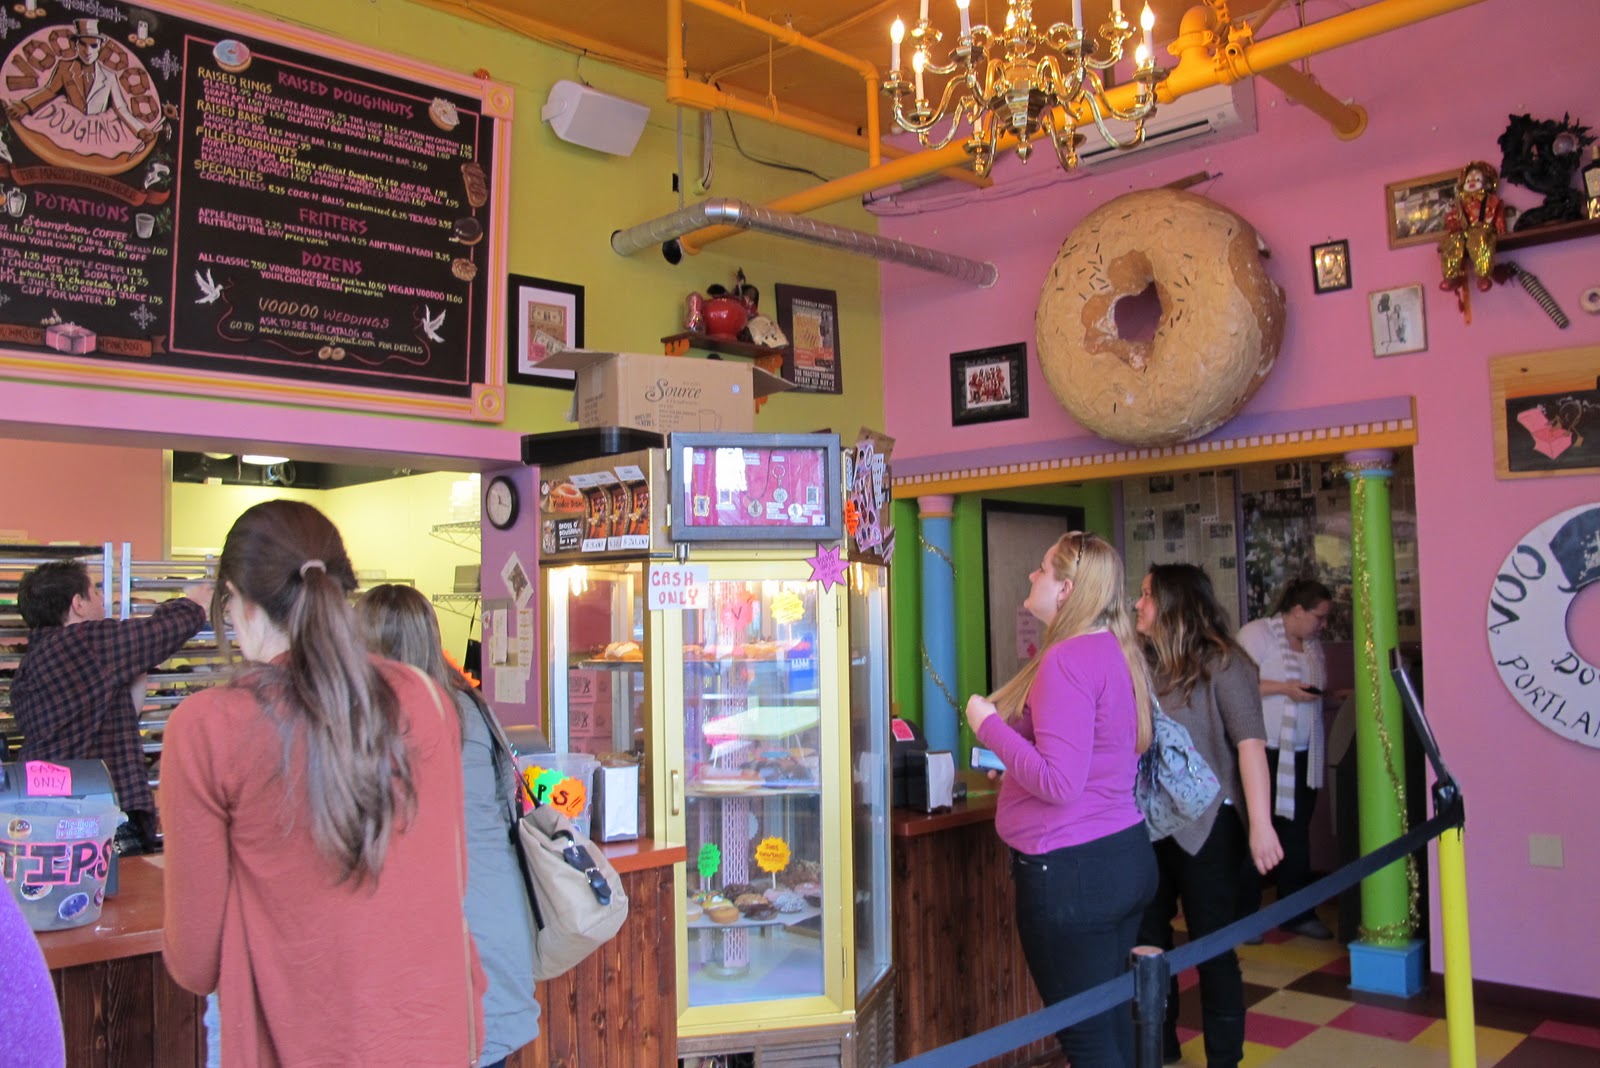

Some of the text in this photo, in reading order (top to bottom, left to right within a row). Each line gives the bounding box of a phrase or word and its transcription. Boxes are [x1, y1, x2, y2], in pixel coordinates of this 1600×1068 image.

[198, 66, 272, 94] RAISED RINGS
[278, 71, 414, 119] RAISED DOUGHNUTS
[197, 99, 264, 125] RAISED BARS
[203, 80, 459, 148] GLAZED CHOCOLATE FROSTING THE CAPTAIN CAPTAIN
[204, 88, 458, 155] GRAPE APE DIRT DOUGHNUT MIAMI VICE BERRY NO NAME
[205, 95, 435, 157] DOUBLE BUBBLE OLD DIRTY BASTARD ORANGUTANG
[196, 126, 298, 157] FILLED DOUGHNUTS
[203, 121, 298, 149] MAPLE BLAZER BLUNT
[203, 112, 428, 171] CHOCOLATE BAR 1.25 MAPLE BAR BACON MAPLE BAR 2.50
[194, 159, 264, 182] SPECIALTIES
[201, 153, 411, 204] RASPBERRY ROMEO LEMON POWDERED SUGAR
[202, 137, 431, 193] PORTLAND CREAM Portland's official Doughnut GAY BAR
[263, 158, 443, 205] CREAM MANGO TANGO VOODOO DOLL
[34, 190, 130, 223] POTATIONS
[346, 202, 390, 217] customized
[23, 214, 128, 242] Stumptown COFFEE
[199, 216, 284, 238] FRITTER OF THE DAY
[199, 207, 434, 259] APPLE FRITTER MEMPHIS MAFIA THAT PEACH
[299, 207, 368, 235] FRITTERS
[28, 236, 147, 262] YOUR OWN CUP FOR OFF
[36, 230, 124, 249] REFILLS 1.75
[2, 248, 143, 276] TEA 1.25 HOT APPLE CIDER 1.25
[8, 257, 62, 274] CHOCOLATE
[65, 266, 79, 276] 1.25
[84, 269, 109, 280] SODA
[110, 273, 128, 284] POP
[130, 277, 149, 287] 1.25
[199, 252, 445, 300] ALL CLASSIC VOODOO DOZEN VEGAN VOODOO
[302, 250, 363, 275] DOZENS
[28, 278, 147, 302] JUICE ORANGE JUICE
[69, 277, 113, 290] chocolate
[260, 270, 343, 292] YOUR CHOICE DOZEN
[21, 285, 103, 306] CUP FOR WATER
[259, 297, 390, 330] VOODOO WEDDINGS
[230, 320, 423, 355] GO TO www.voodoodoughnut.com FOR DETAILS
[259, 317, 374, 340] ASK TO SEE THE CATALOG OR
[645, 378, 702, 402] Source
[652, 571, 694, 587] CASH
[659, 588, 699, 605] ONLY
[1551, 652, 1600, 685] DO
[1498, 655, 1600, 738] PORTLA
[33, 776, 66, 791] ONLY
[0, 838, 115, 886] TIPS
